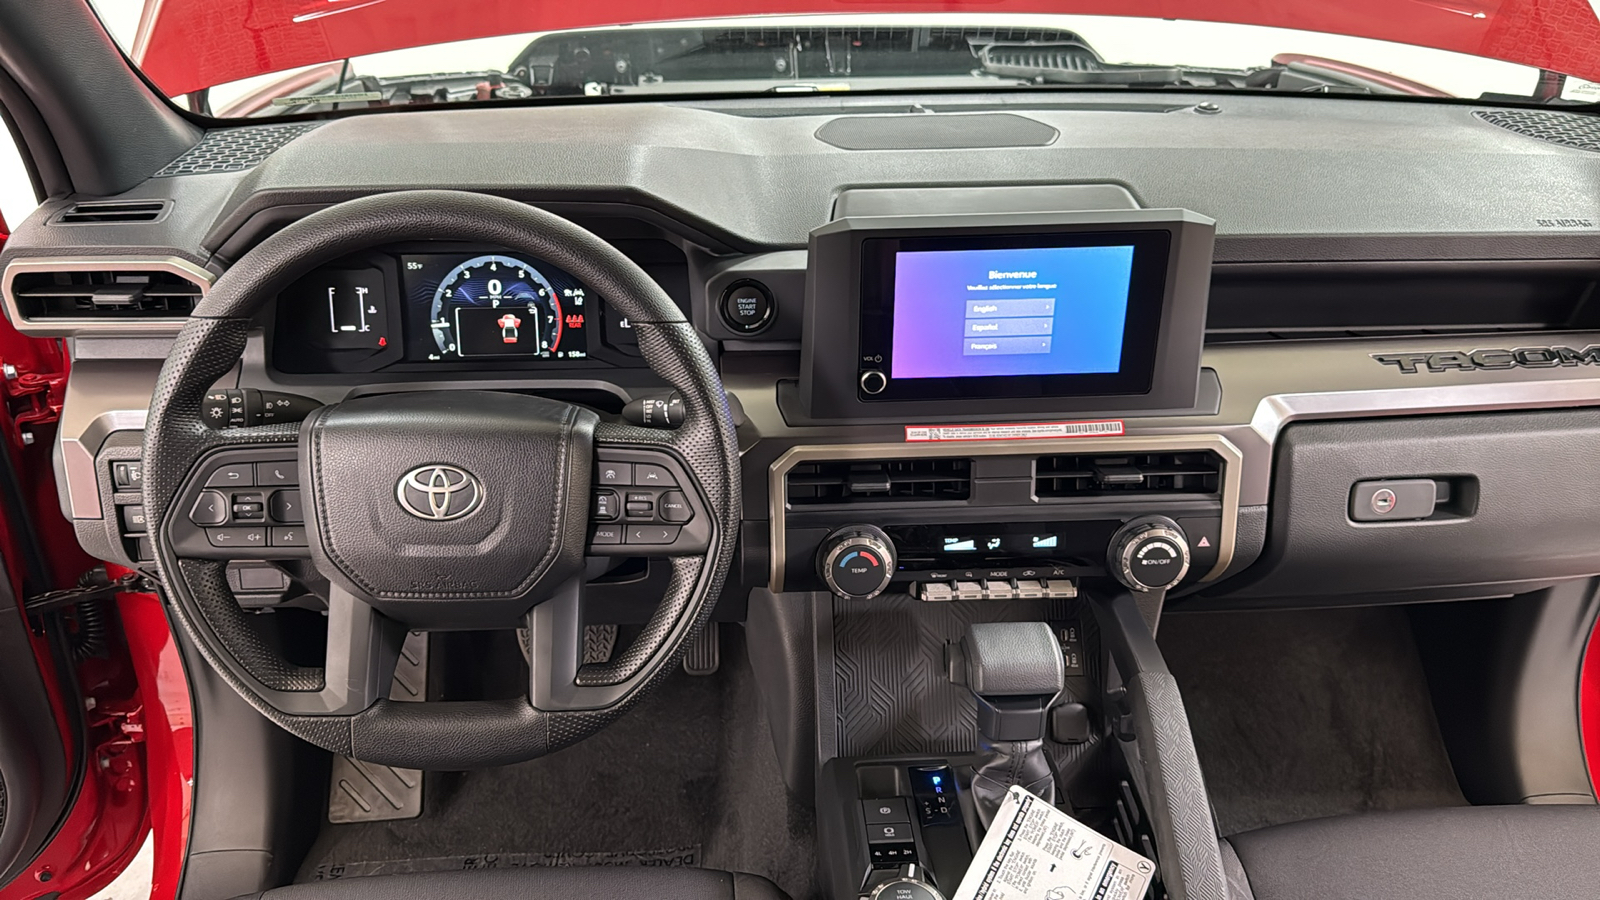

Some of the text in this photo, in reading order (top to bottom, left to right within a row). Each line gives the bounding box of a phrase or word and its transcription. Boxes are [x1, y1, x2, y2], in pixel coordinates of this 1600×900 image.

[489, 263, 497, 272] 4
[463, 270, 471, 279] 3
[518, 270, 525, 278] 5
[988, 270, 1038, 279] Bienvenue
[487, 279, 502, 295] 0
[445, 289, 453, 298] 2
[538, 289, 546, 297] 6
[492, 300, 500, 308] P
[973, 305, 998, 314] English
[547, 315, 554, 324] 7
[972, 323, 999, 332] Español
[448, 343, 456, 351] 0
[541, 340, 548, 349] 8
[932, 776, 941, 785] P
[1006, 828, 1016, 839] does
[1011, 822, 1019, 830] not
[1139, 862, 1151, 873] Y
